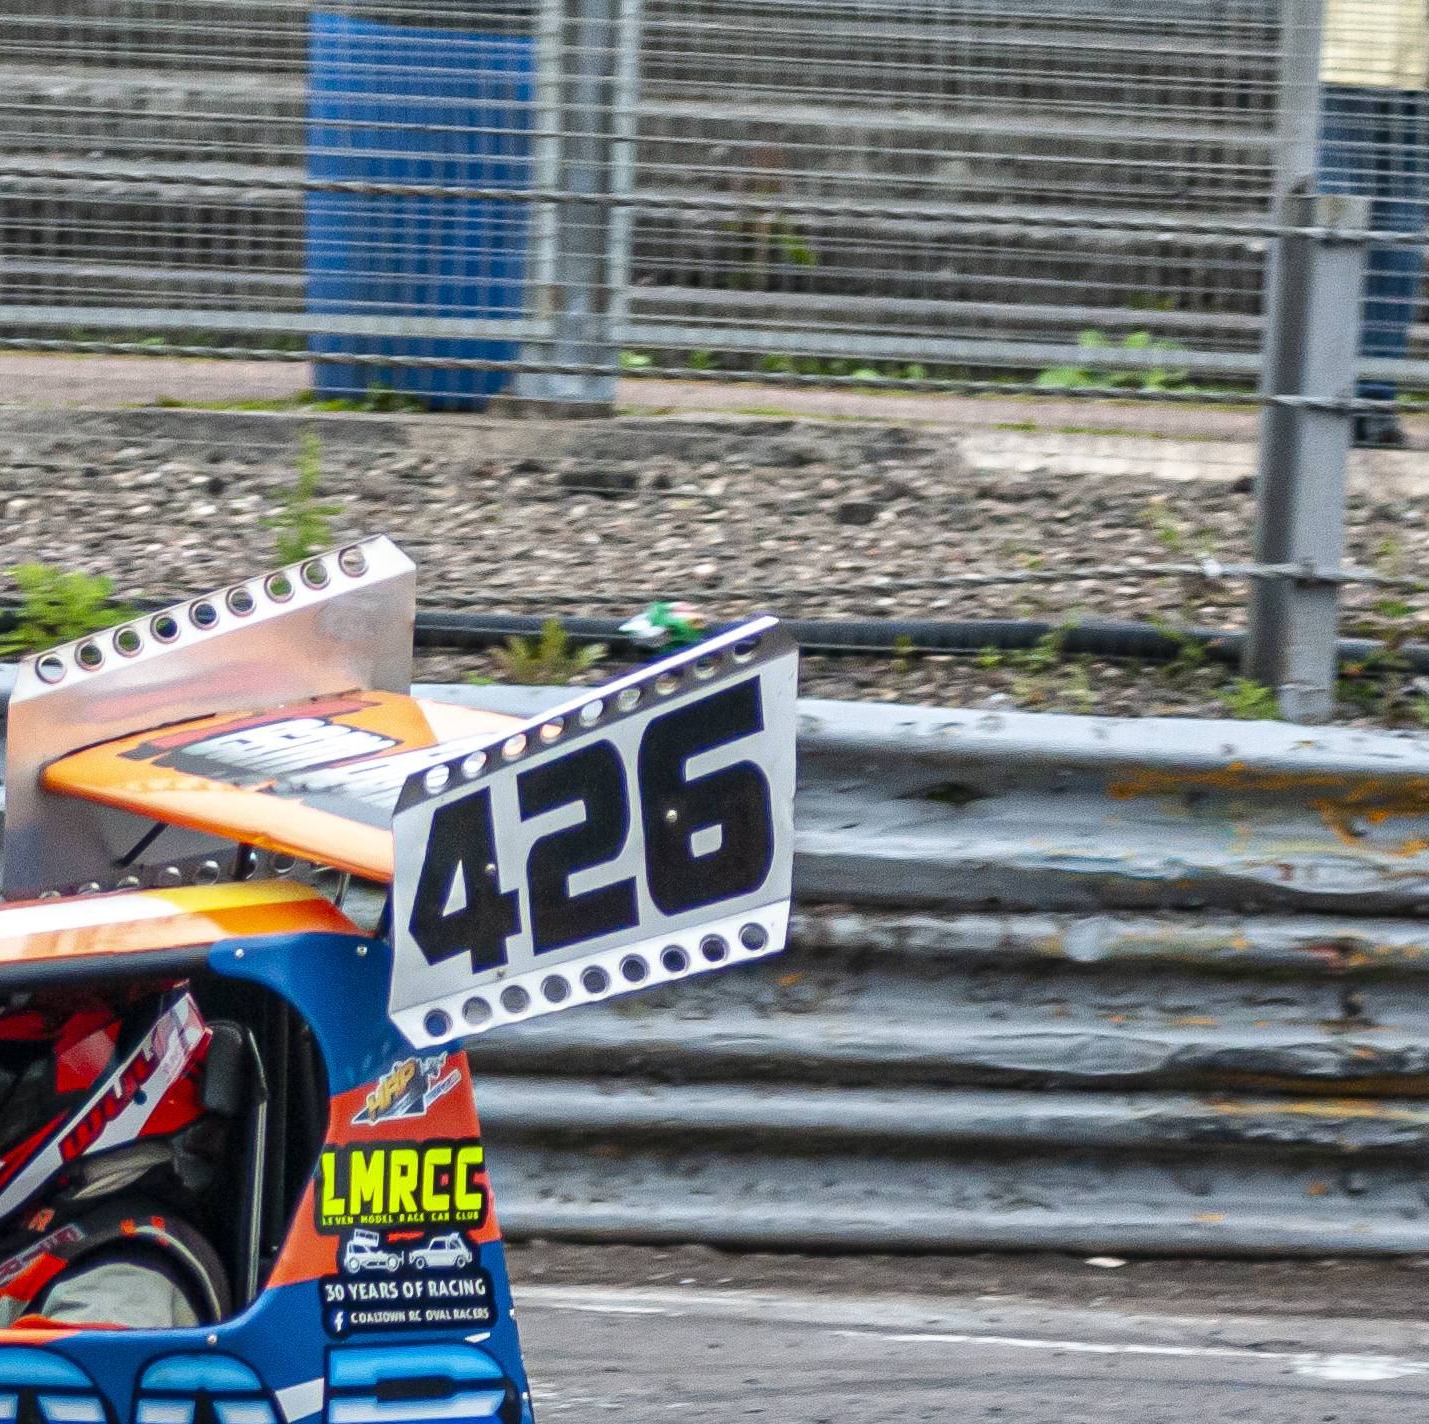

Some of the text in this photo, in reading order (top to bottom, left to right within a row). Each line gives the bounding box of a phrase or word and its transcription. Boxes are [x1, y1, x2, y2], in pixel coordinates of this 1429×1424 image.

[410, 674, 775, 974] 426
[321, 1146, 484, 1216] LMRCC
[360, 1214, 393, 1225] MODEL
[399, 1212, 425, 1223] RACE
[431, 1211, 450, 1222] CAR
[455, 1210, 480, 1221] CLUB
[324, 1278, 487, 1302] 30 YEARS OF RACING
[425, 1308, 452, 1322] OVAL
[453, 1306, 490, 1321] RACERS
